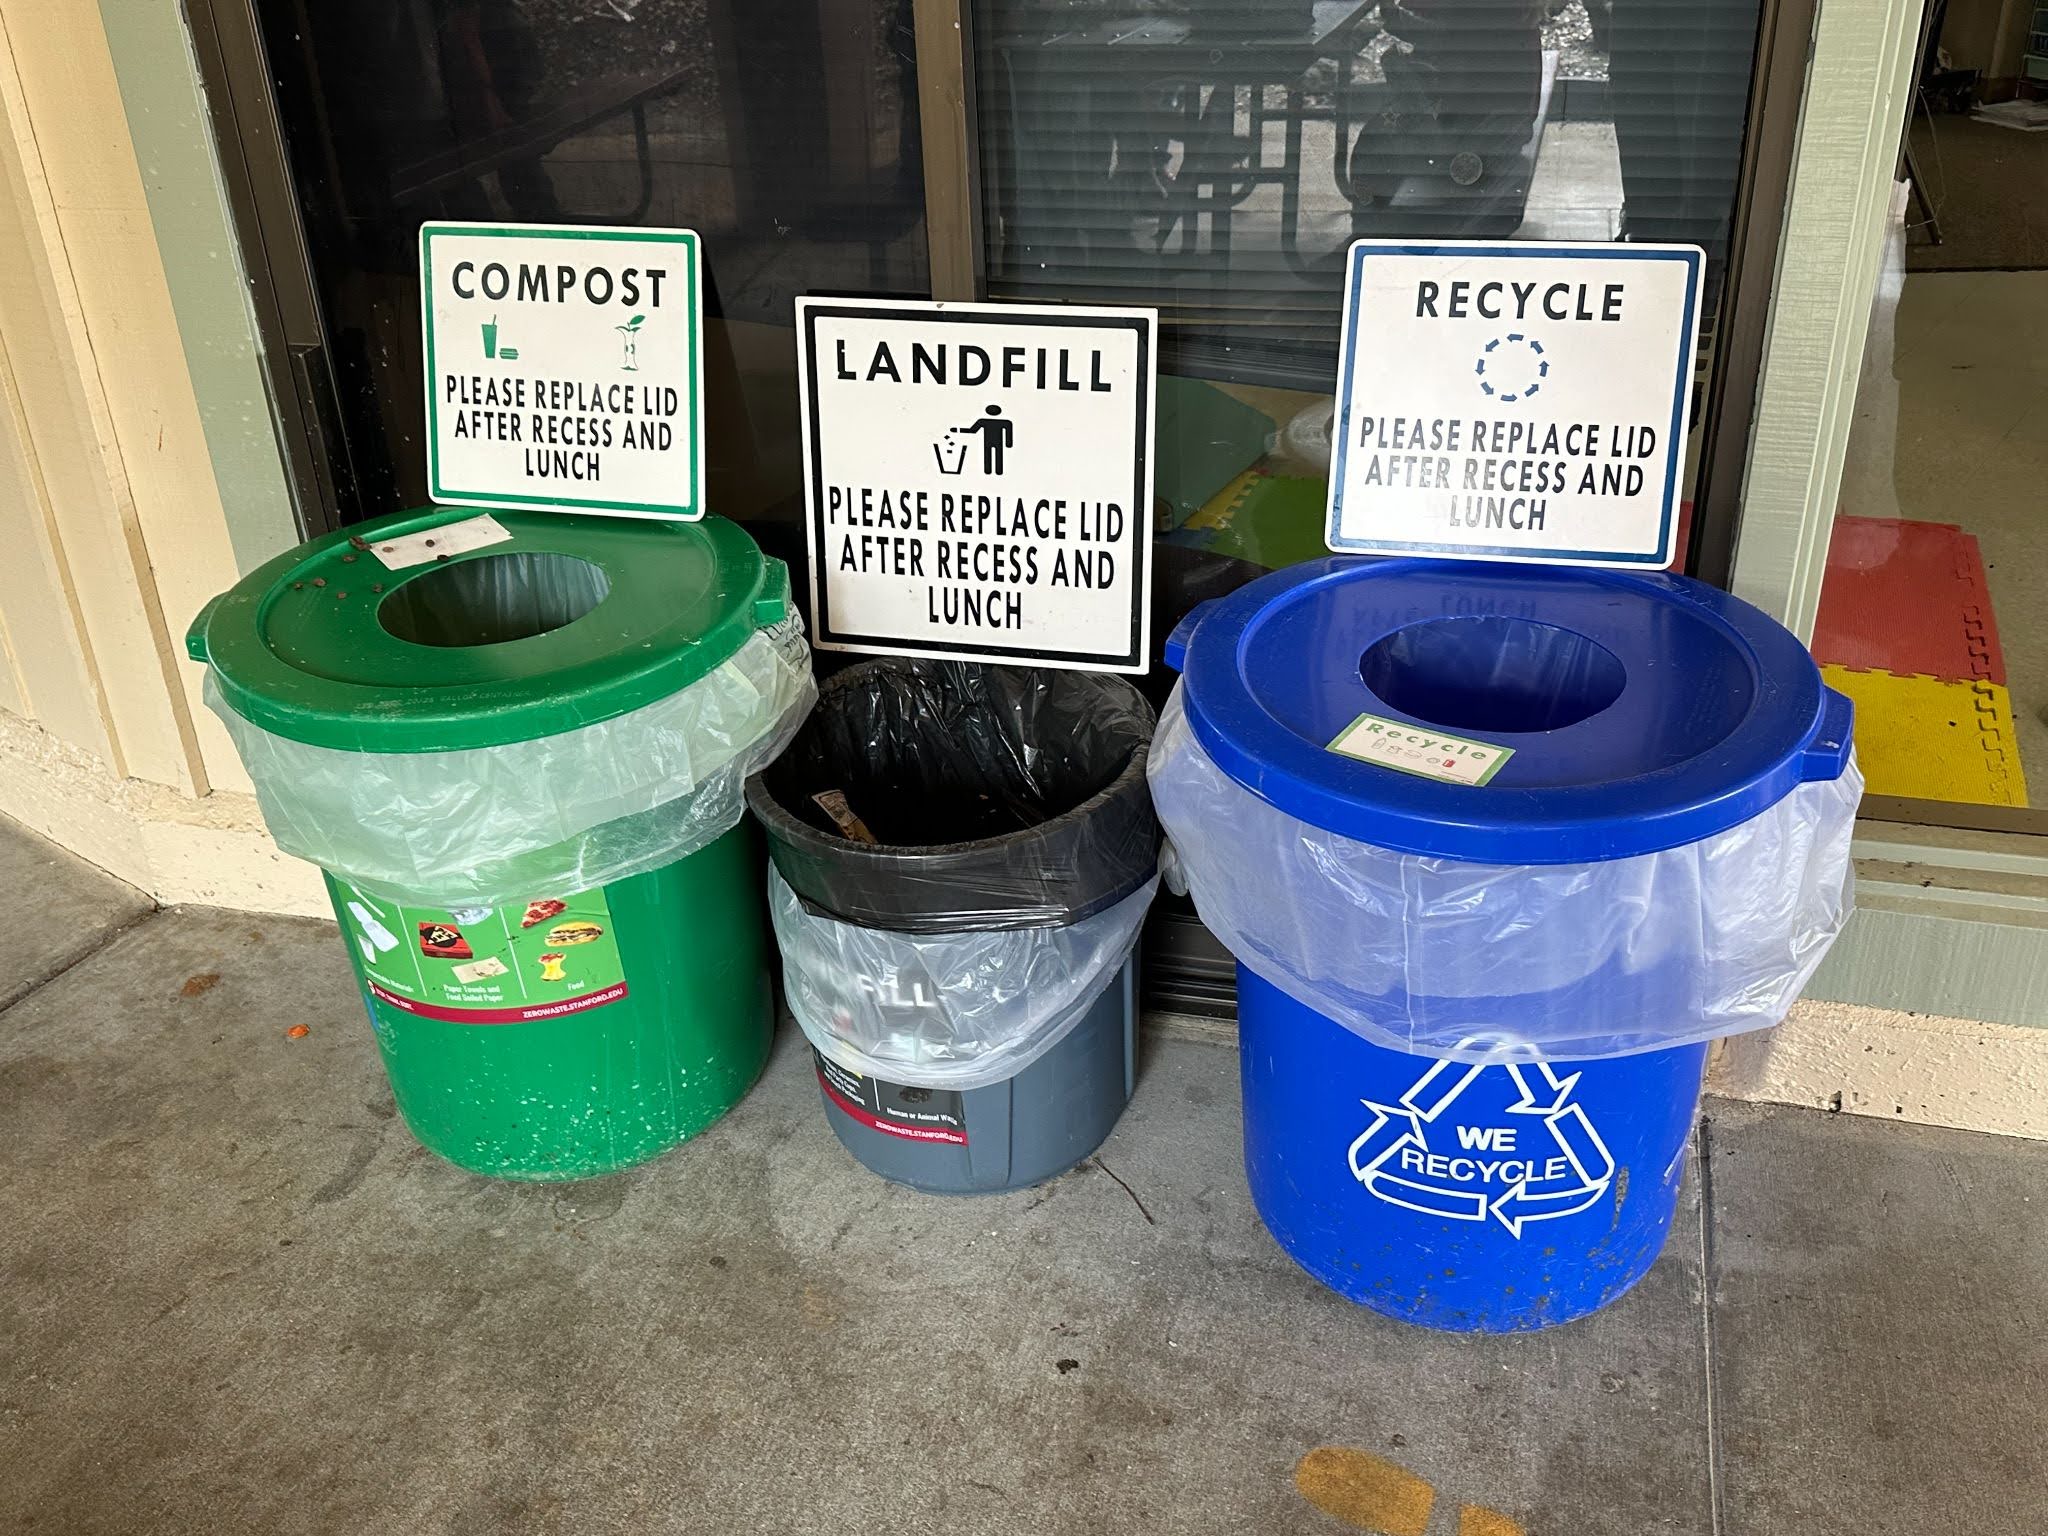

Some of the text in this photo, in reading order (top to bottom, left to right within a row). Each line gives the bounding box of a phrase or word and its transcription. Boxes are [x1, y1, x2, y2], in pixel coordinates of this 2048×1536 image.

[452, 261, 666, 307] COMPOST
[1416, 280, 1624, 321] RECYCLE
[836, 339, 1111, 393] LANDFILL
[446, 375, 678, 417] PLEASE REPLACE LID
[455, 410, 672, 451] AFTER RECESS AND
[1359, 416, 1657, 459] PLEASE REPLACE LID
[525, 448, 600, 481] LUNCH
[1364, 454, 1644, 497] AFTER RECESS AND
[829, 486, 1124, 543] PLEASE REPLACE LID
[1449, 494, 1547, 531] LUNCH
[840, 533, 1115, 590] AFTER RECESS AND
[928, 585, 1022, 630] LUNCH
[1366, 723, 1487, 760] Recycle
[522, 988, 624, 1019] ZEROWASTE.STANFORD.EDU
[567, 980, 585, 991] Food
[886, 1107, 908, 1119] Human
[917, 1113, 939, 1121] Animal
[1456, 1125, 1517, 1152] WE
[1401, 1148, 1567, 1184] RECYCLE
